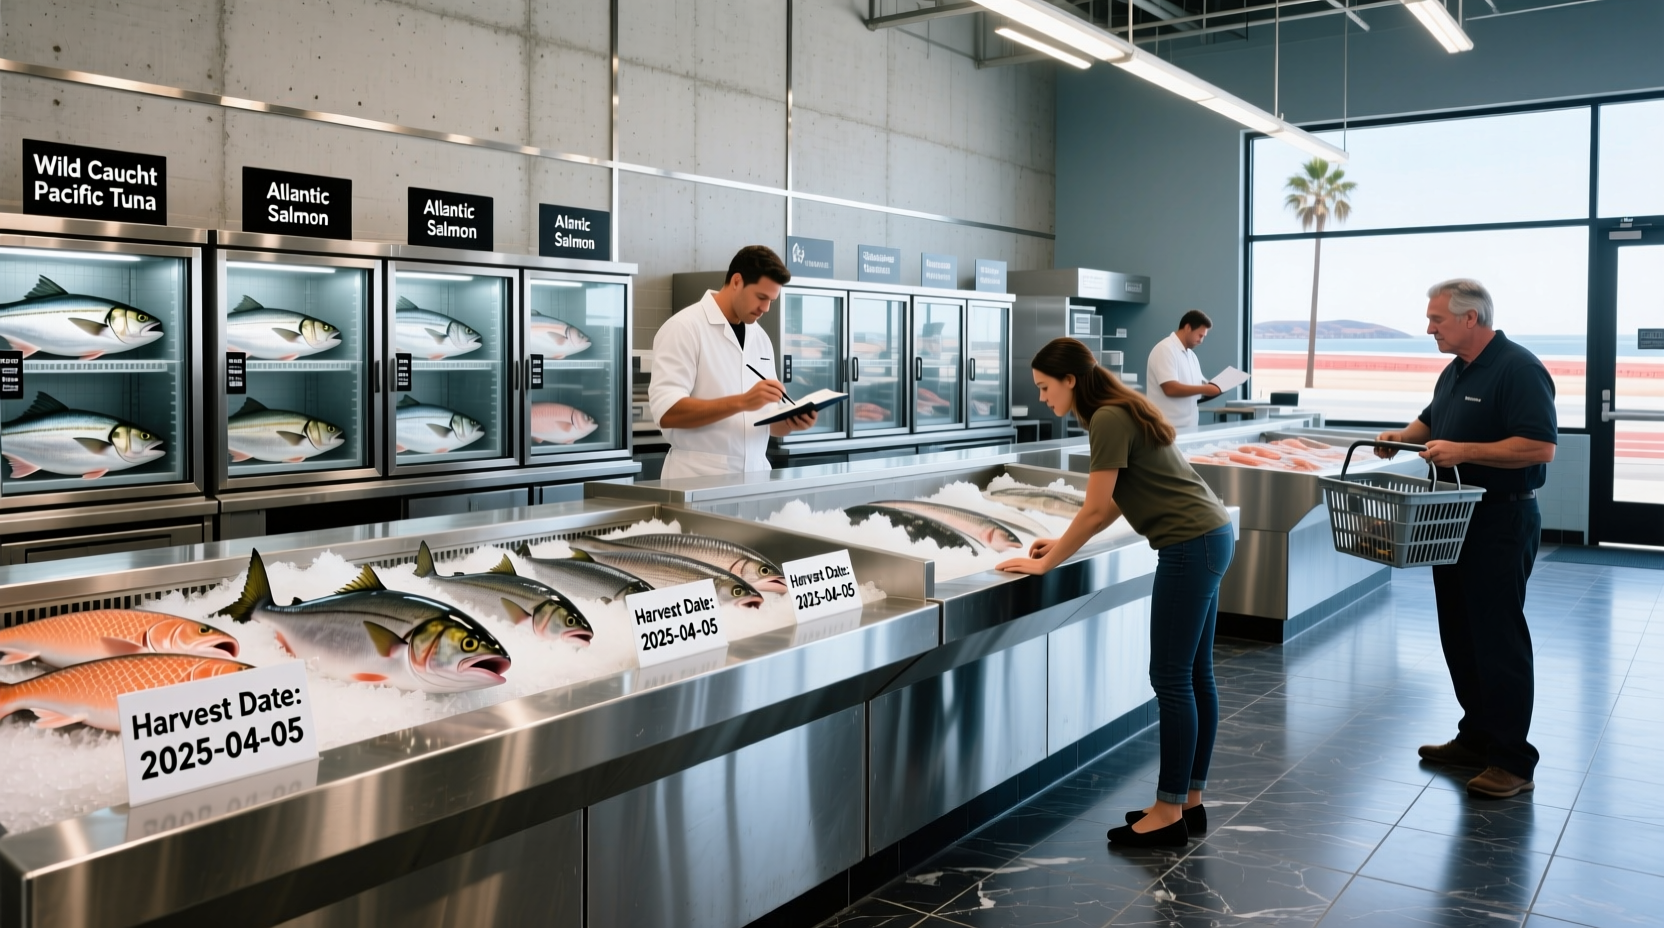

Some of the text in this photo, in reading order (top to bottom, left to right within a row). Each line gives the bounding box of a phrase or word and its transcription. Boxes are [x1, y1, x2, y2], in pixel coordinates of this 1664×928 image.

[33, 154, 81, 178] Wild
[34, 180, 156, 211] Pacific Tuna
[268, 204, 329, 226] Salmon
[427, 219, 477, 239] Salmon
[554, 231, 595, 250] Salmon
[634, 602, 682, 625] Harvest
[641, 617, 718, 651] 2025-04-05
[131, 687, 302, 740] Harvest Date:
[140, 716, 304, 781] 2025-04-05
